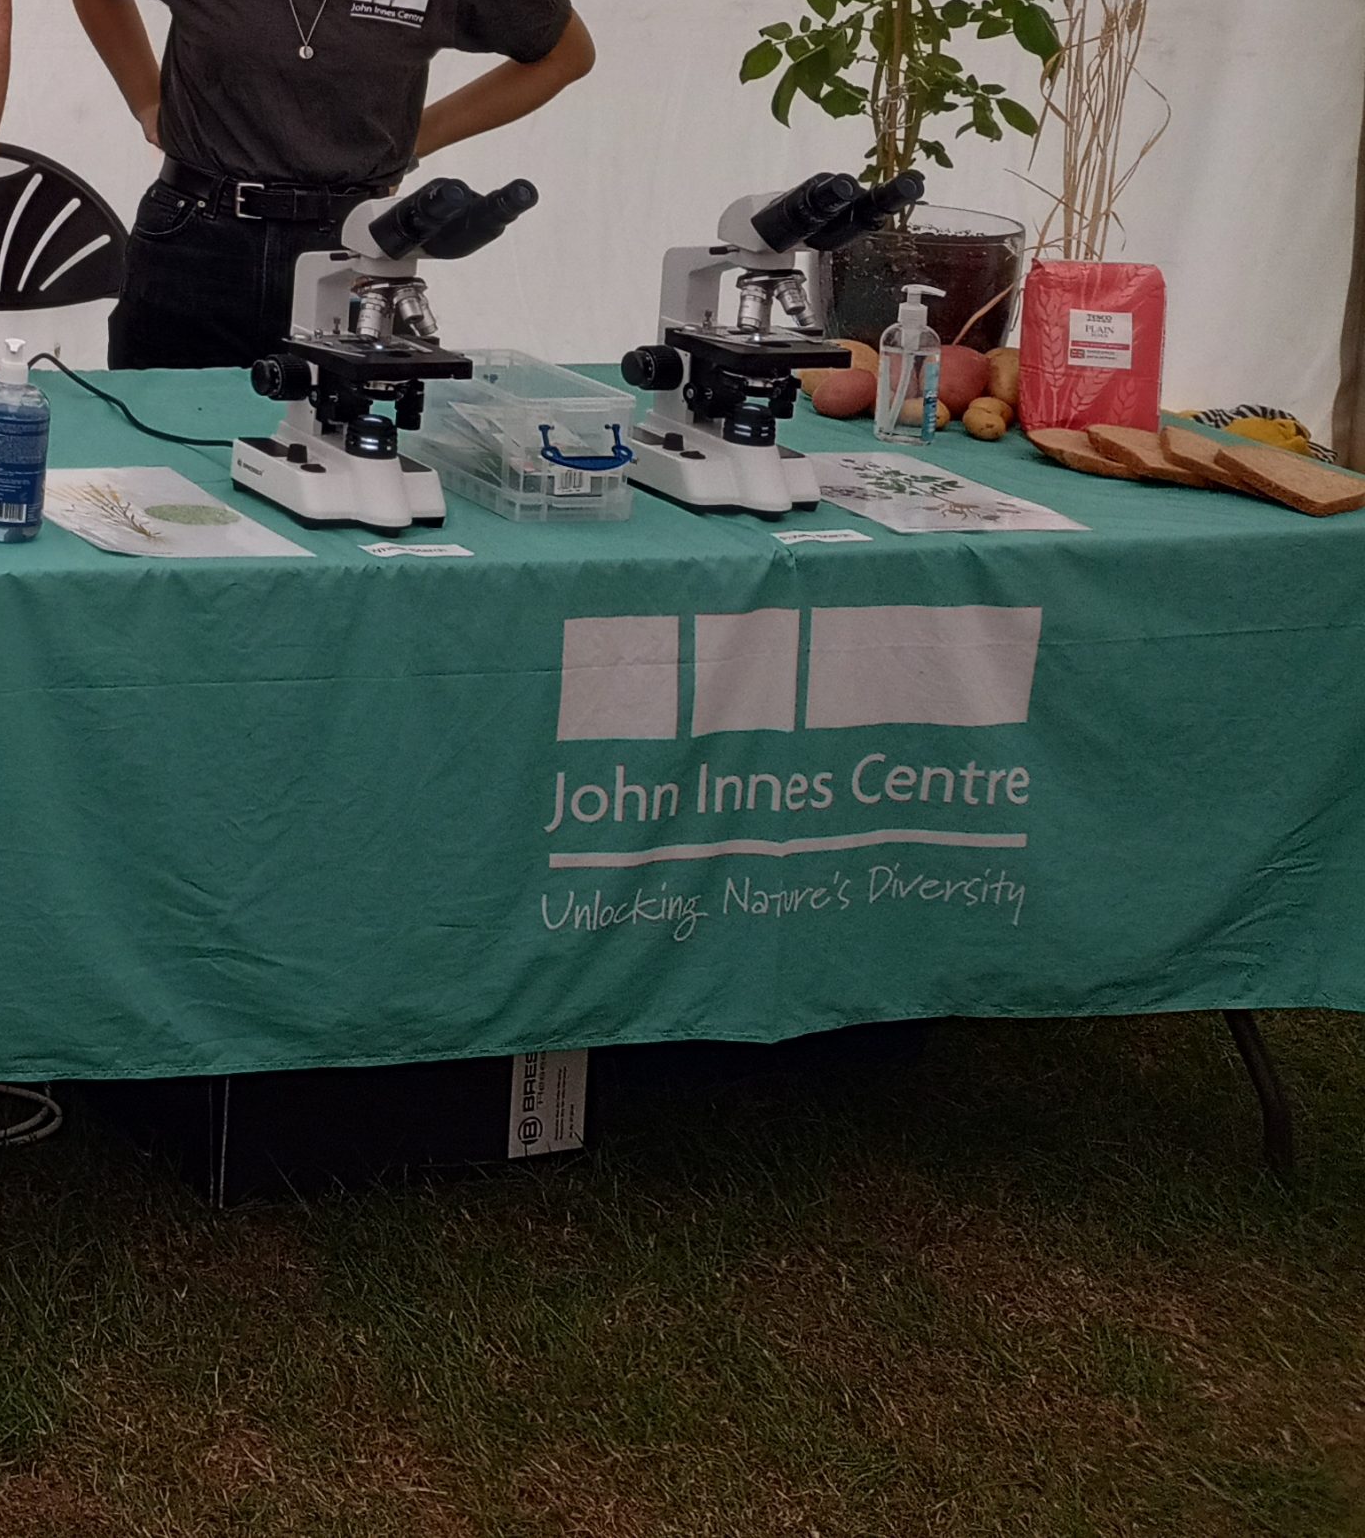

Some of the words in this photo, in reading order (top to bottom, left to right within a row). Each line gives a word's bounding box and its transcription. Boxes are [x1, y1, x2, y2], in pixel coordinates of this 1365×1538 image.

[351, 3, 372, 12] John
[374, 6, 396, 17] Innes
[397, 10, 424, 23] Centre
[544, 763, 680, 833] John
[697, 761, 833, 812] Innes
[852, 753, 1030, 806] Centre
[541, 882, 709, 943] Unlocking
[722, 871, 852, 918] Nature's
[869, 863, 1027, 926] Diversity
